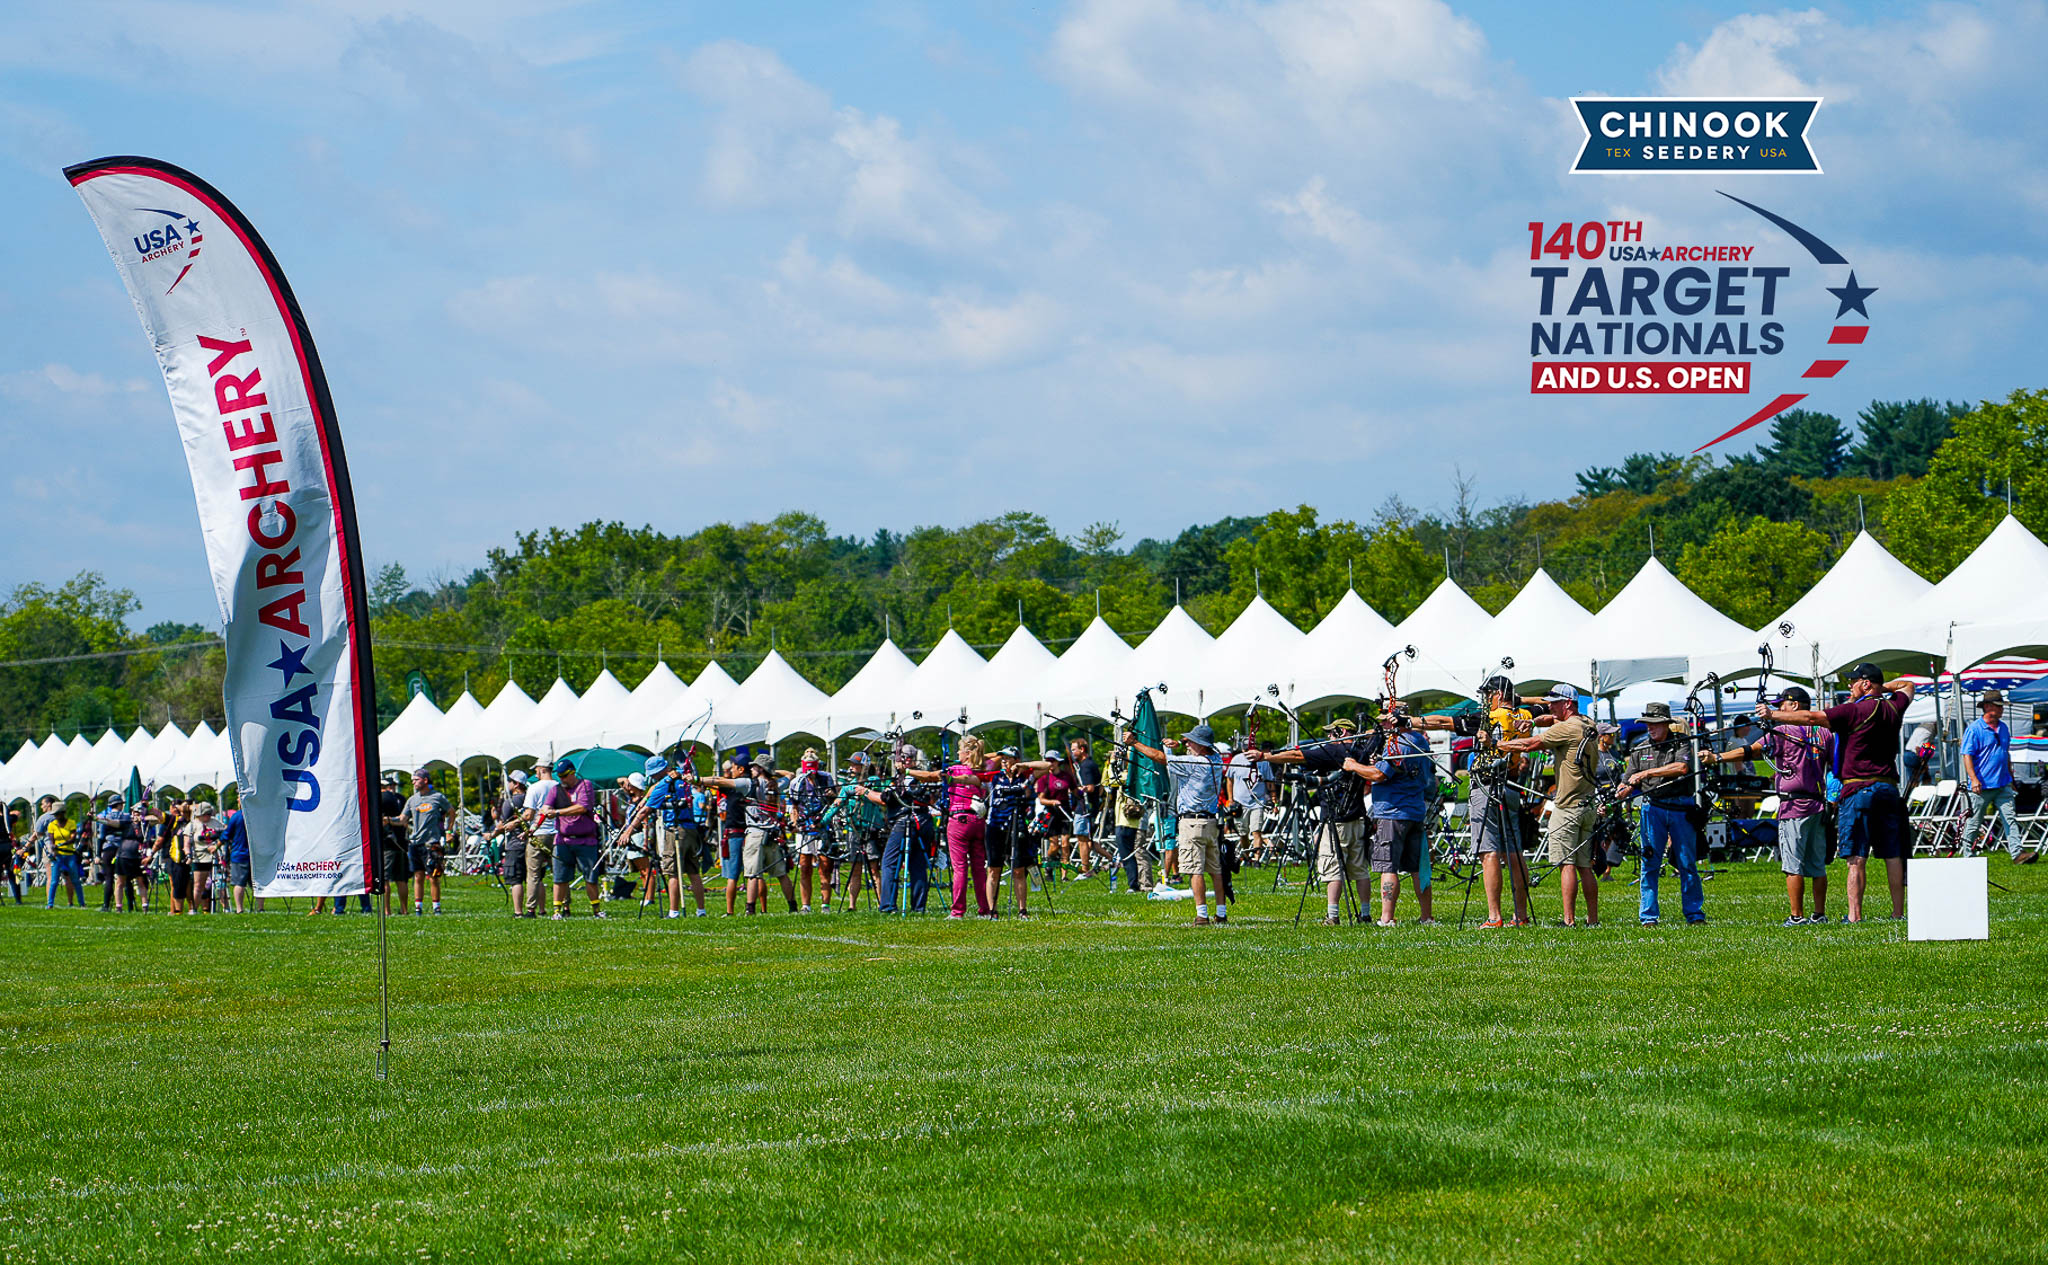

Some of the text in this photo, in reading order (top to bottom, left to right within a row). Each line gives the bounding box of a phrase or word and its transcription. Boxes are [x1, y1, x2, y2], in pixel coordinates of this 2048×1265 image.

[133, 223, 183, 255] USA
[142, 241, 185, 264] ARCHERY
[196, 334, 311, 639] ARCHERY
[269, 682, 322, 813] USA
[295, 860, 343, 872] ARCHERY
